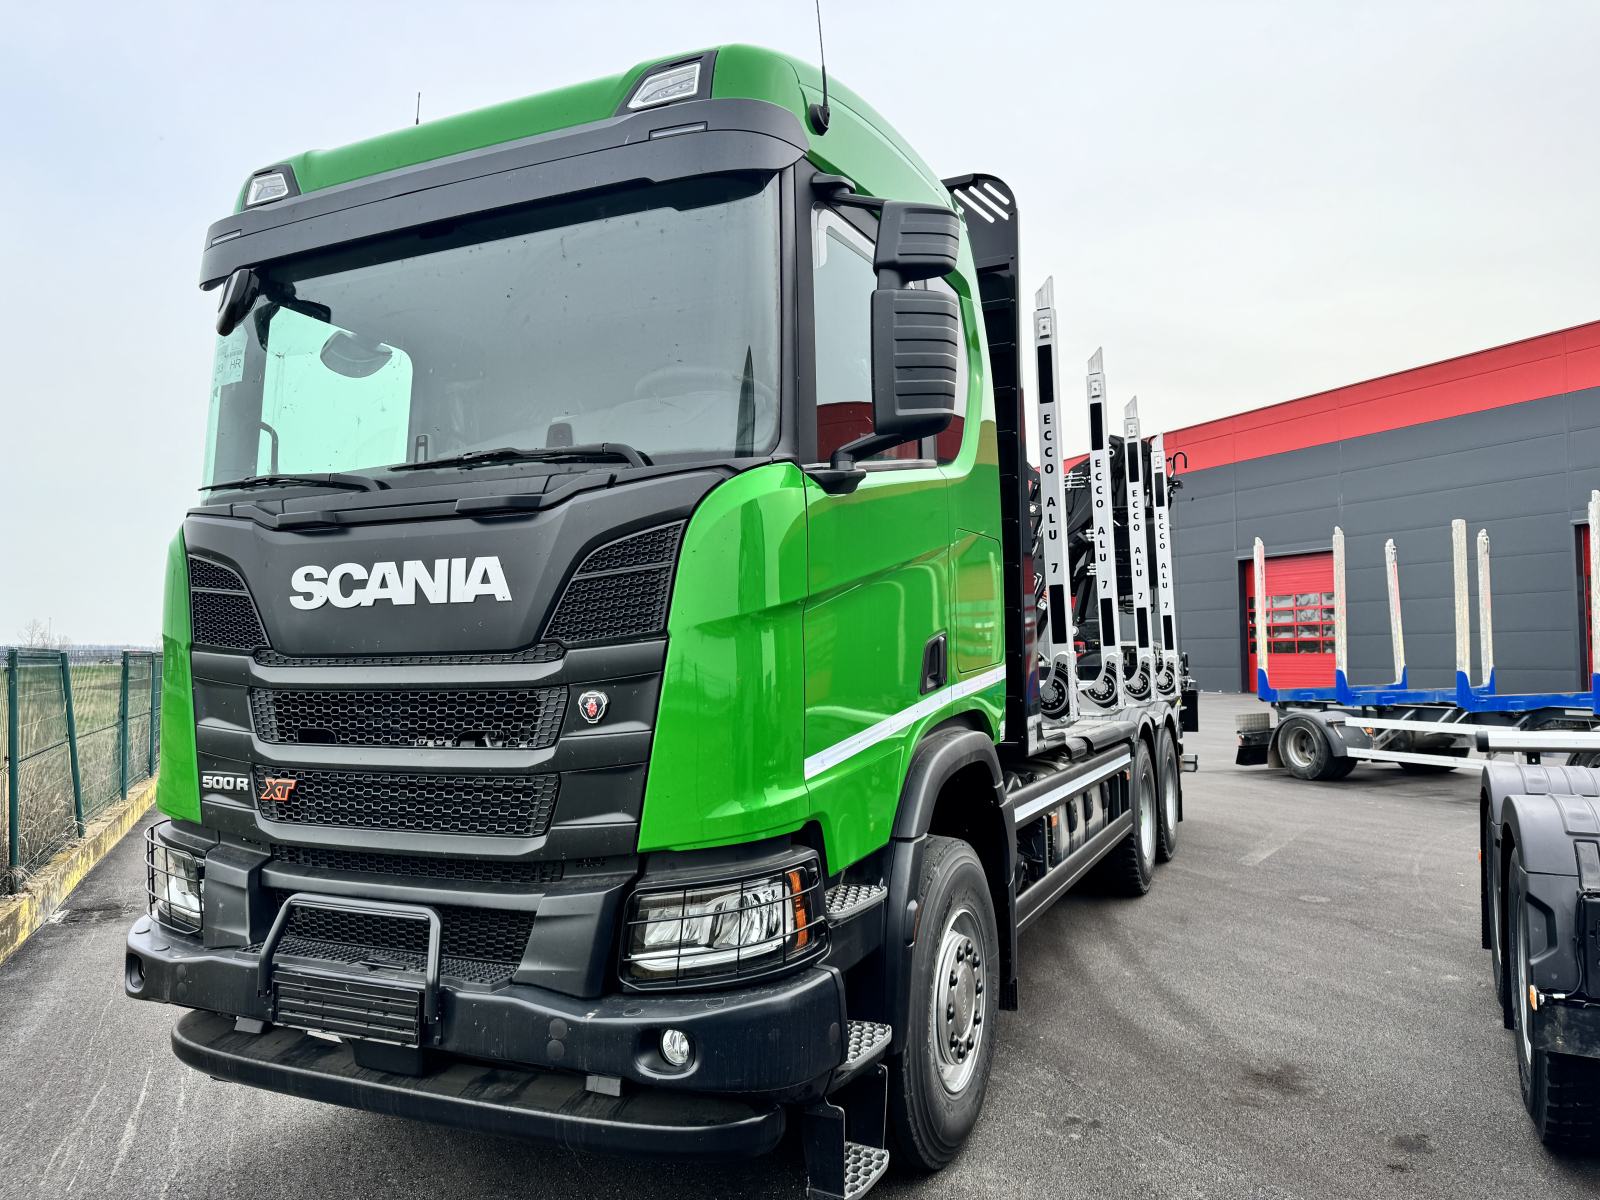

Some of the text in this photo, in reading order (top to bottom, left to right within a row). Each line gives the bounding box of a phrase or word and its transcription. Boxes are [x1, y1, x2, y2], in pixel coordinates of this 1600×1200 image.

[1043, 414, 1059, 574] ECCO ALU 7
[1132, 489, 1140, 532] ECCO
[1095, 459, 1108, 589] ECCO ALU 7
[1158, 513, 1166, 550] ECCO
[1134, 546, 1143, 577] ALU
[1160, 562, 1168, 589] ALU
[289, 556, 512, 610] SCANIA
[260, 777, 296, 801] XT
